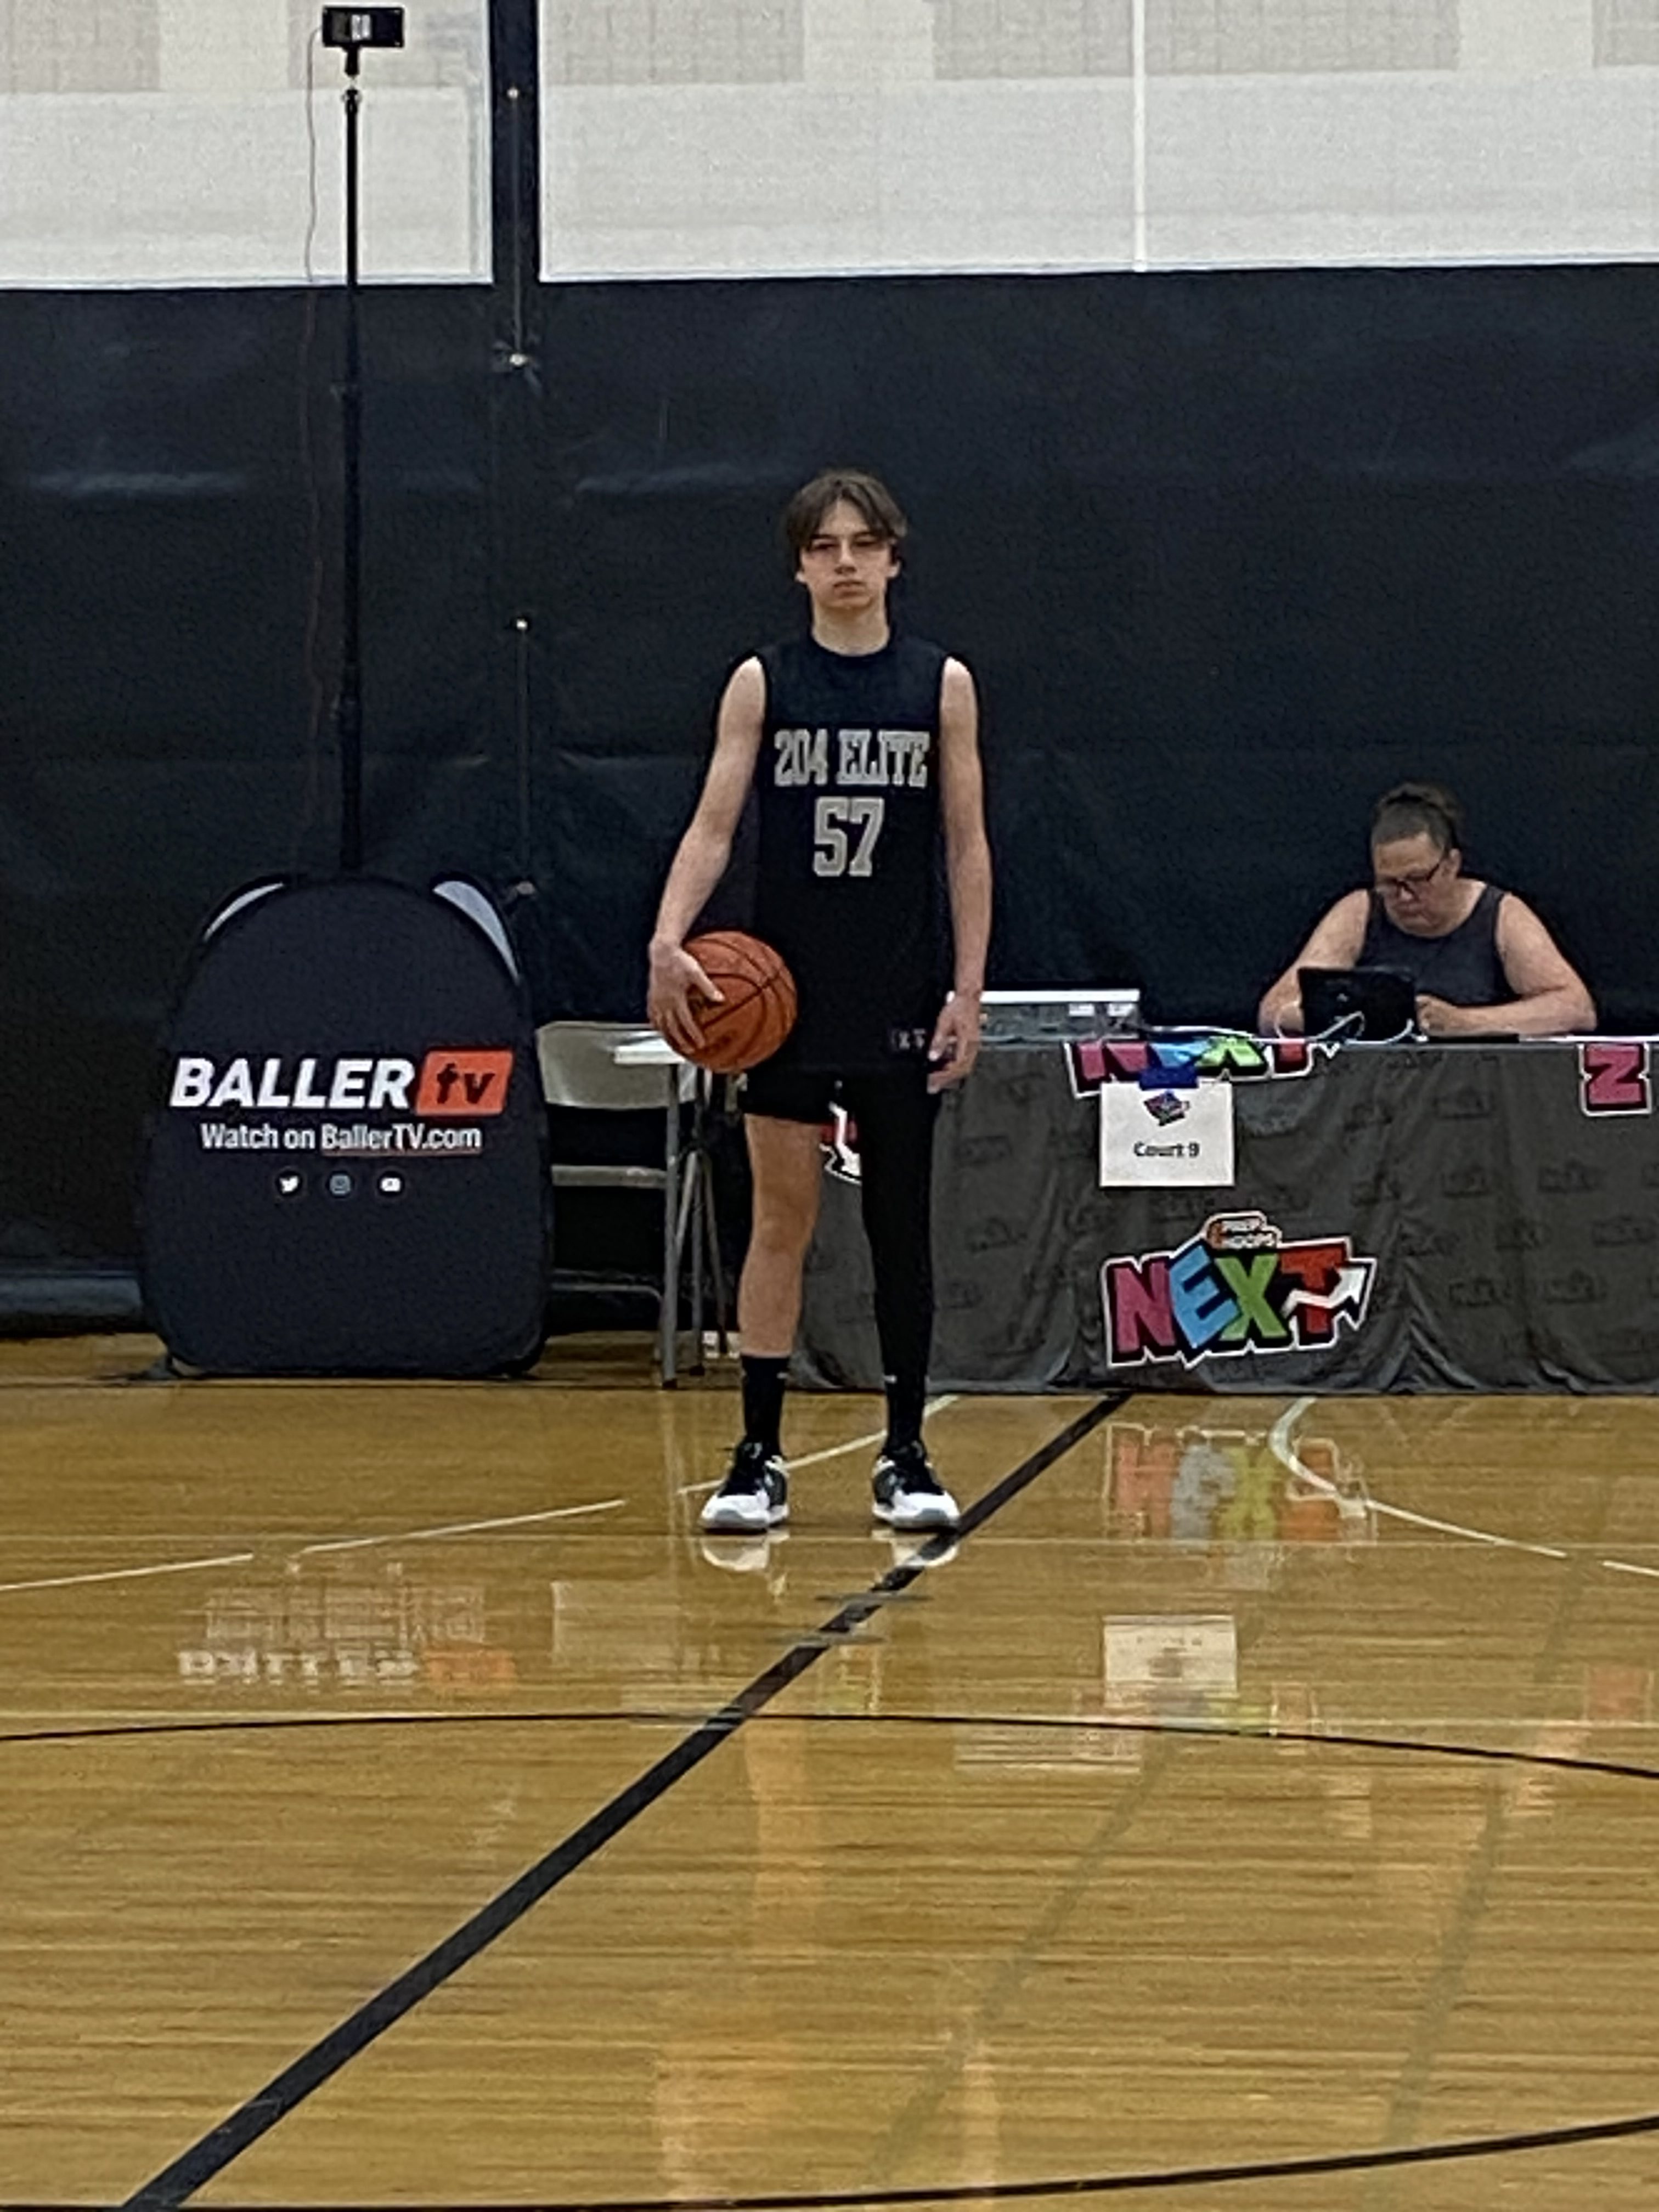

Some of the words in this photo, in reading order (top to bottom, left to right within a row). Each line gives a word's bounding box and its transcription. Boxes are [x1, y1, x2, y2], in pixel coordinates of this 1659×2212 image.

[774, 728, 828, 787] 204
[836, 729, 930, 788] ELITE
[812, 796, 885, 877] 57
[169, 1057, 416, 1109] BALLER
[200, 1122, 278, 1149] Watch
[284, 1127, 315, 1149] on
[321, 1122, 482, 1151] BallerTV.com
[1133, 1141, 1184, 1158] Court
[1188, 1142, 1200, 1158] 9
[1108, 1240, 1350, 1355] NEXT
